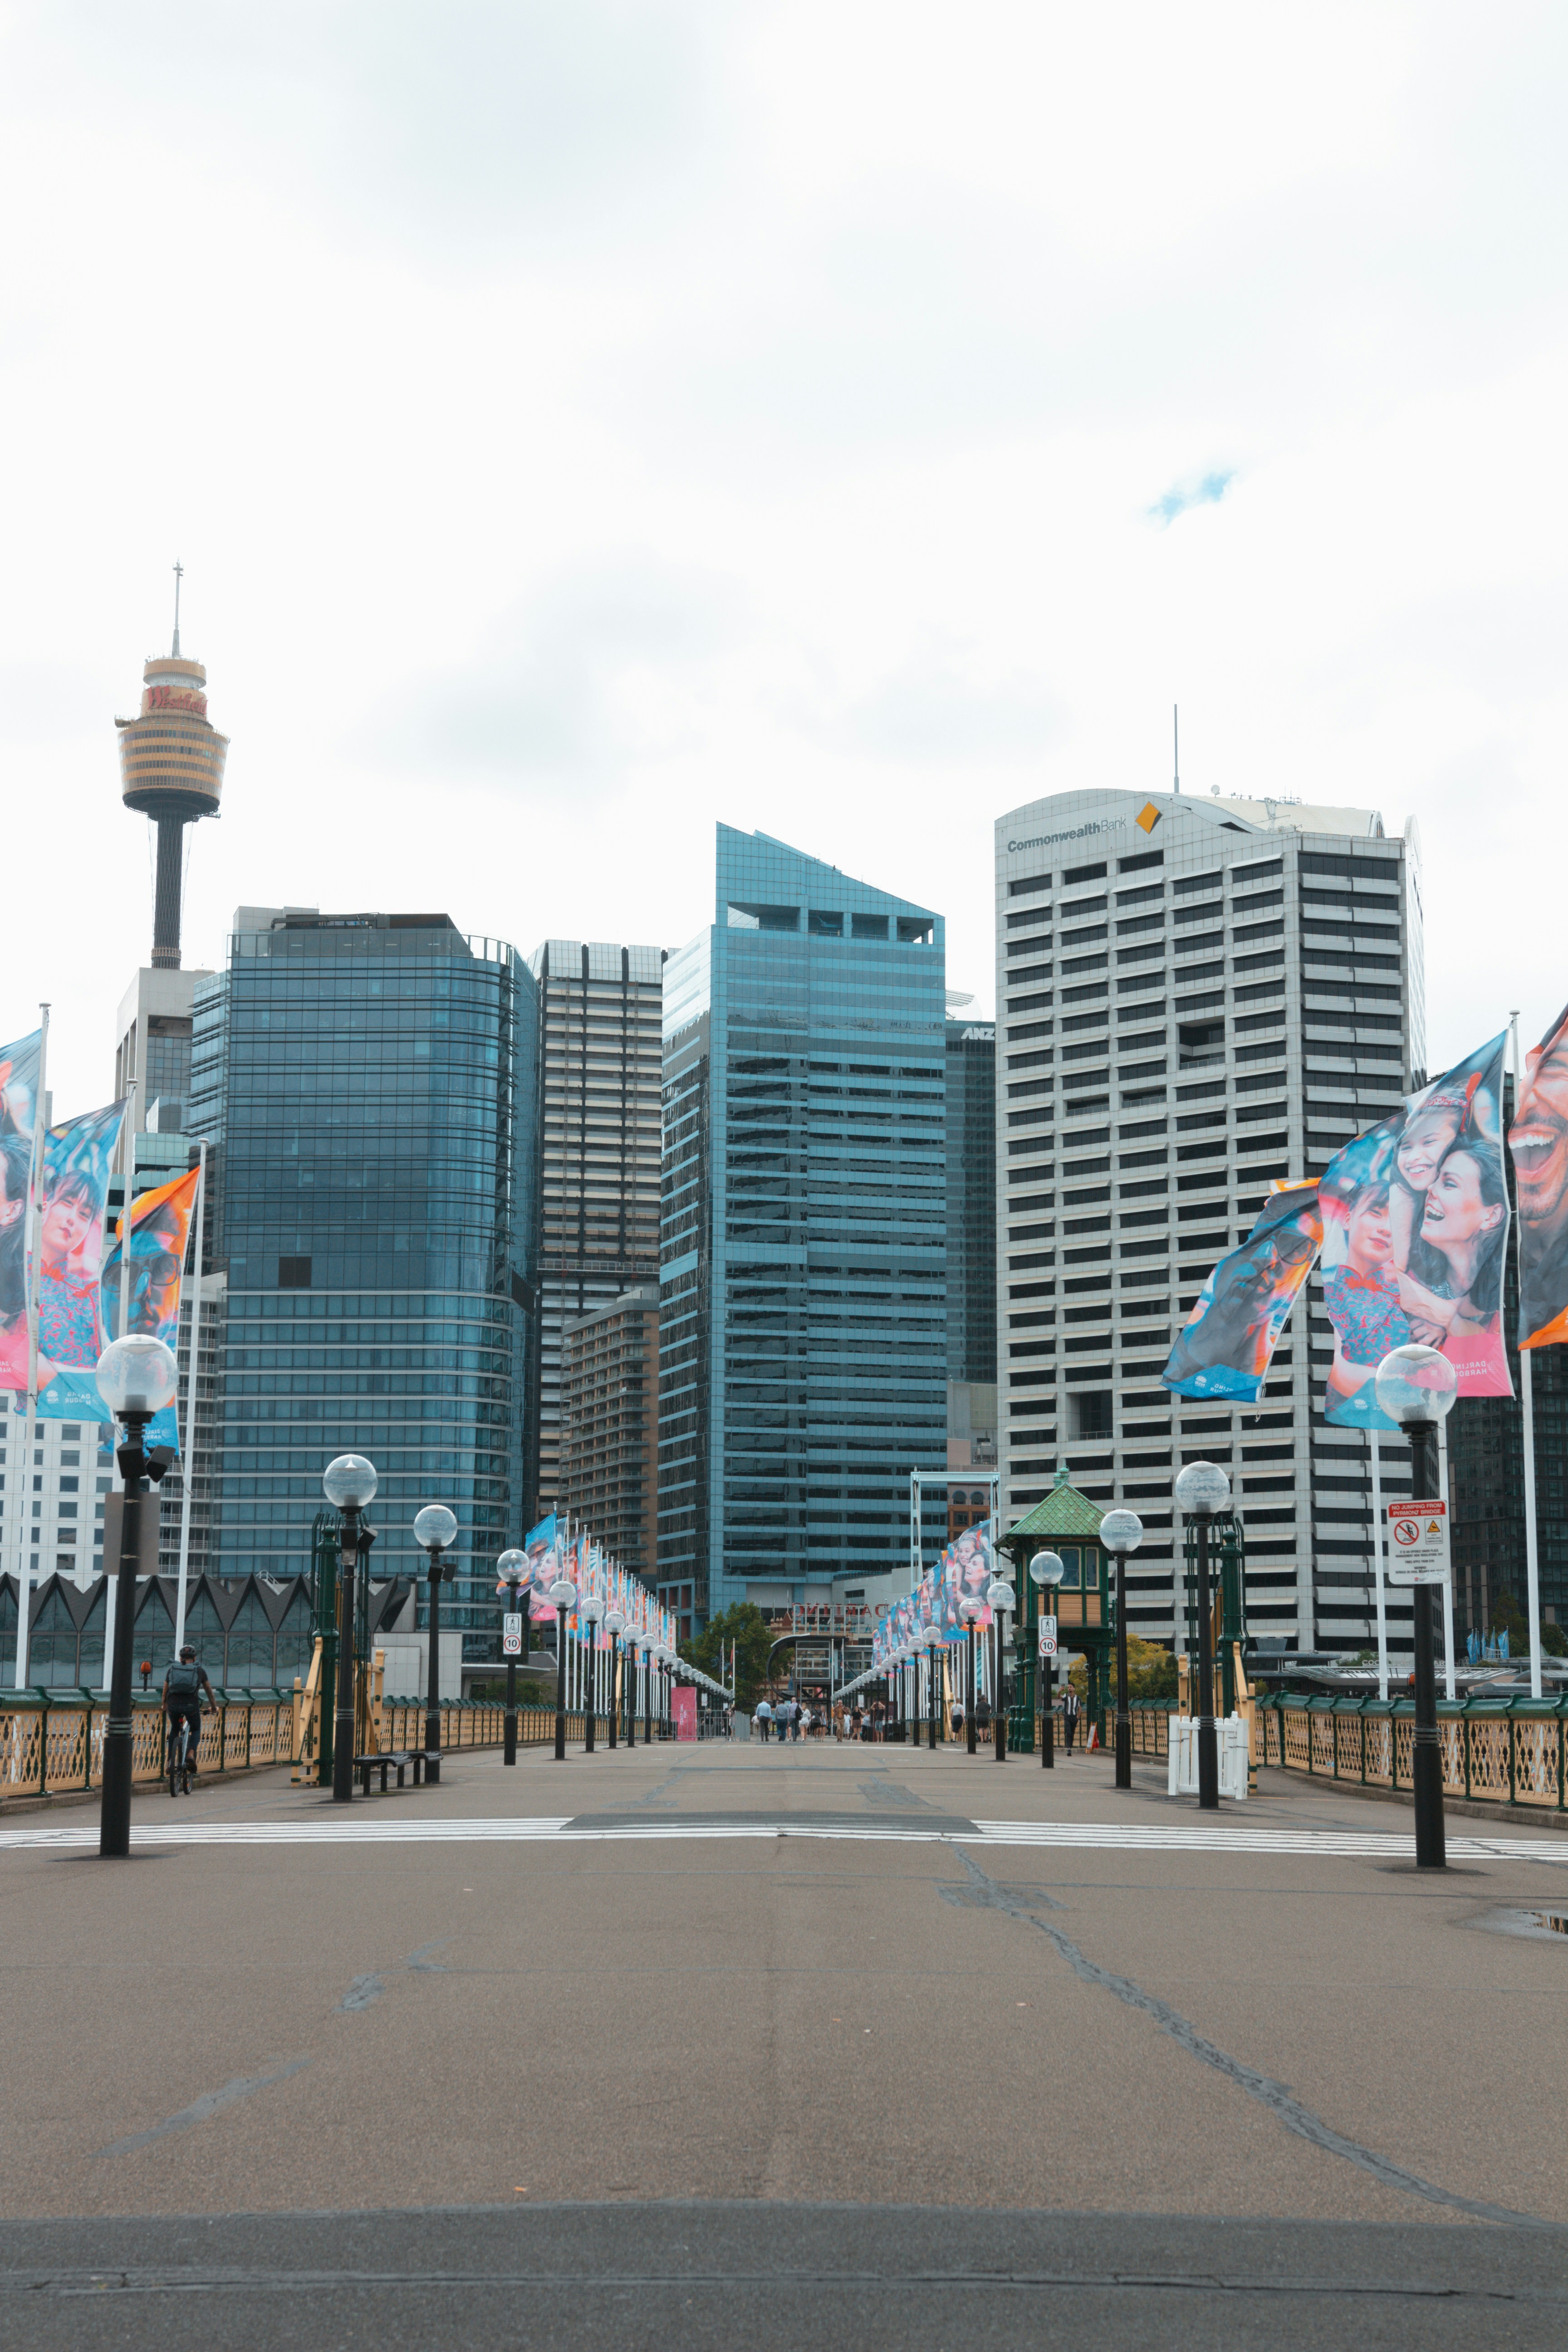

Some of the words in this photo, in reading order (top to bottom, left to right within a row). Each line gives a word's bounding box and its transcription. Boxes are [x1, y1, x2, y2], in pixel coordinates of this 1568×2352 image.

[146, 685, 209, 715] Westfield
[961, 1027, 995, 1041] ANZ
[507, 1639, 517, 1647] 10
[1043, 1642, 1053, 1650] 10
